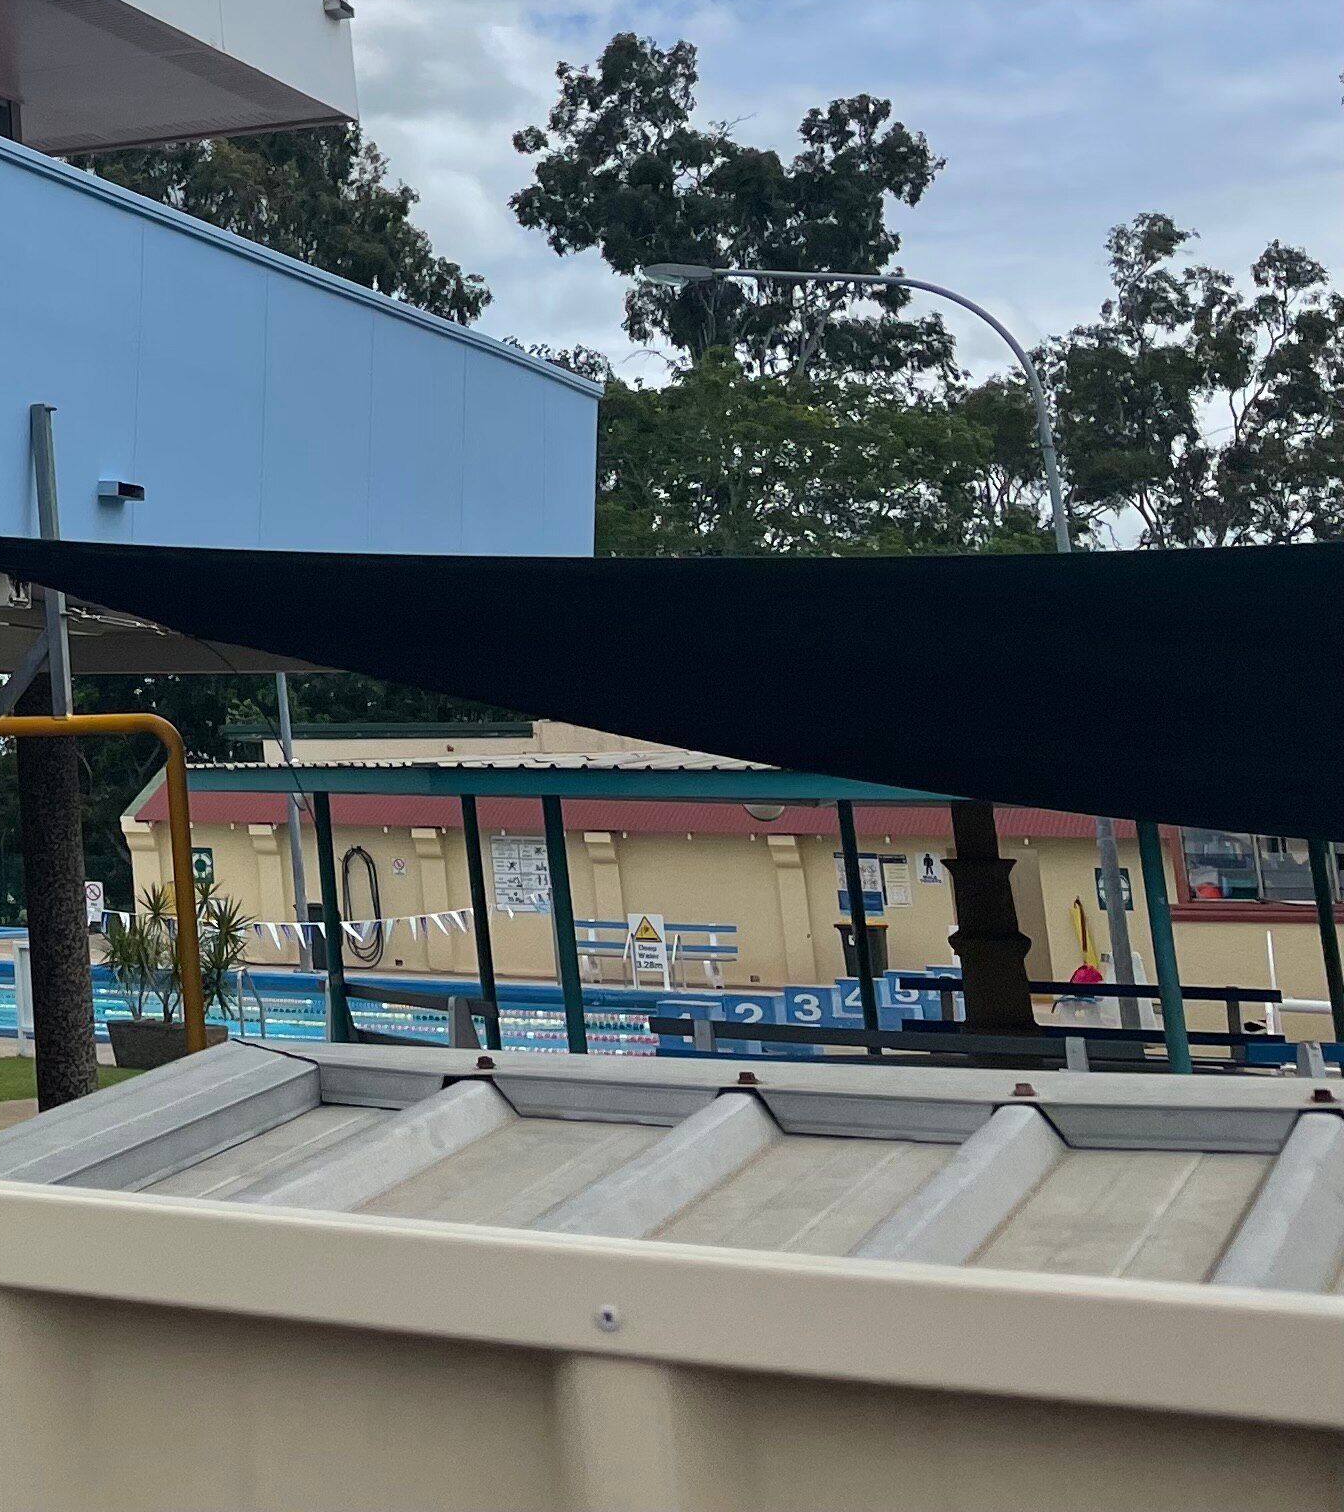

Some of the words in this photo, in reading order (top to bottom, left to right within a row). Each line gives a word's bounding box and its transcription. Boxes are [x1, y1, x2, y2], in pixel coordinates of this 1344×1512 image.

[895, 978, 919, 1003] 5
[735, 1003, 764, 1023] 2
[794, 994, 822, 1021] 3
